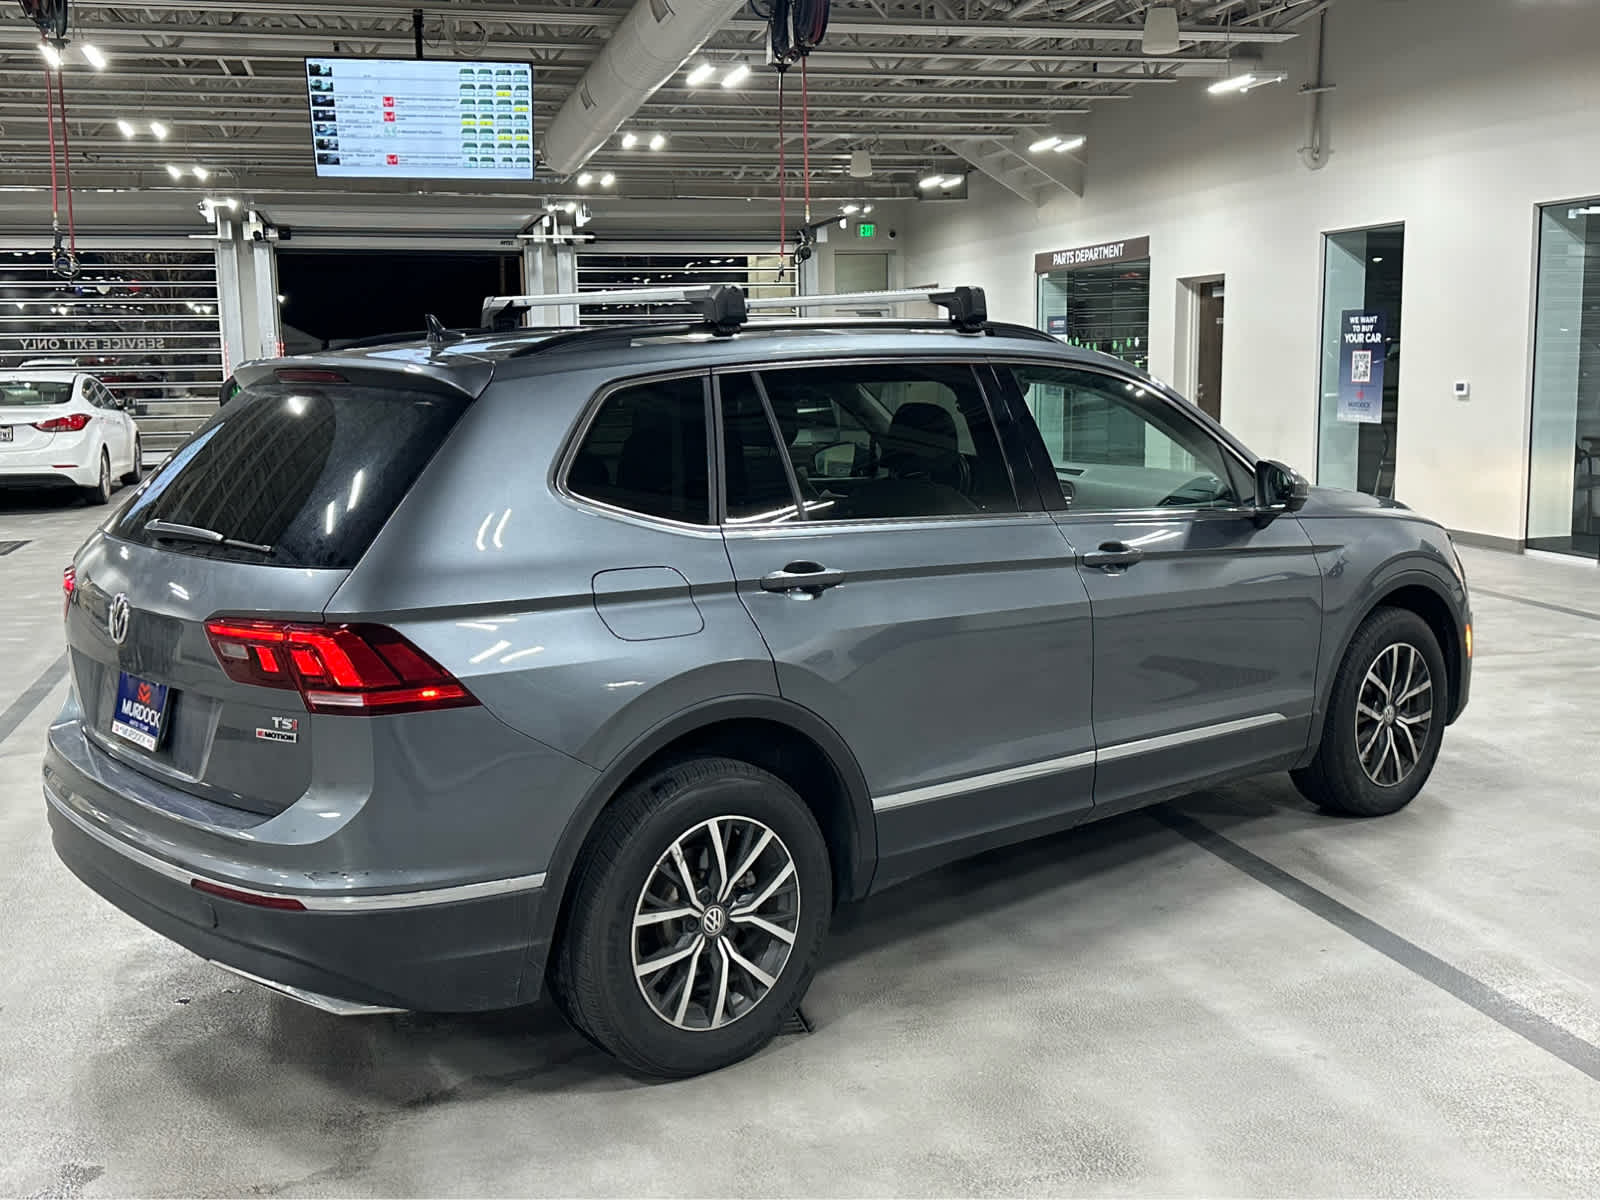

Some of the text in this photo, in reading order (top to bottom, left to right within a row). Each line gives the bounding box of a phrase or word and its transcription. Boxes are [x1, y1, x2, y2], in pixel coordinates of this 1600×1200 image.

[1052, 243, 1125, 265] PARTS DEPARTMENT
[1349, 315, 1378, 324] WE WANT
[1352, 324, 1374, 333] TO BUY
[1344, 333, 1382, 344] YOUR CAR
[121, 698, 161, 729] MURDOCK
